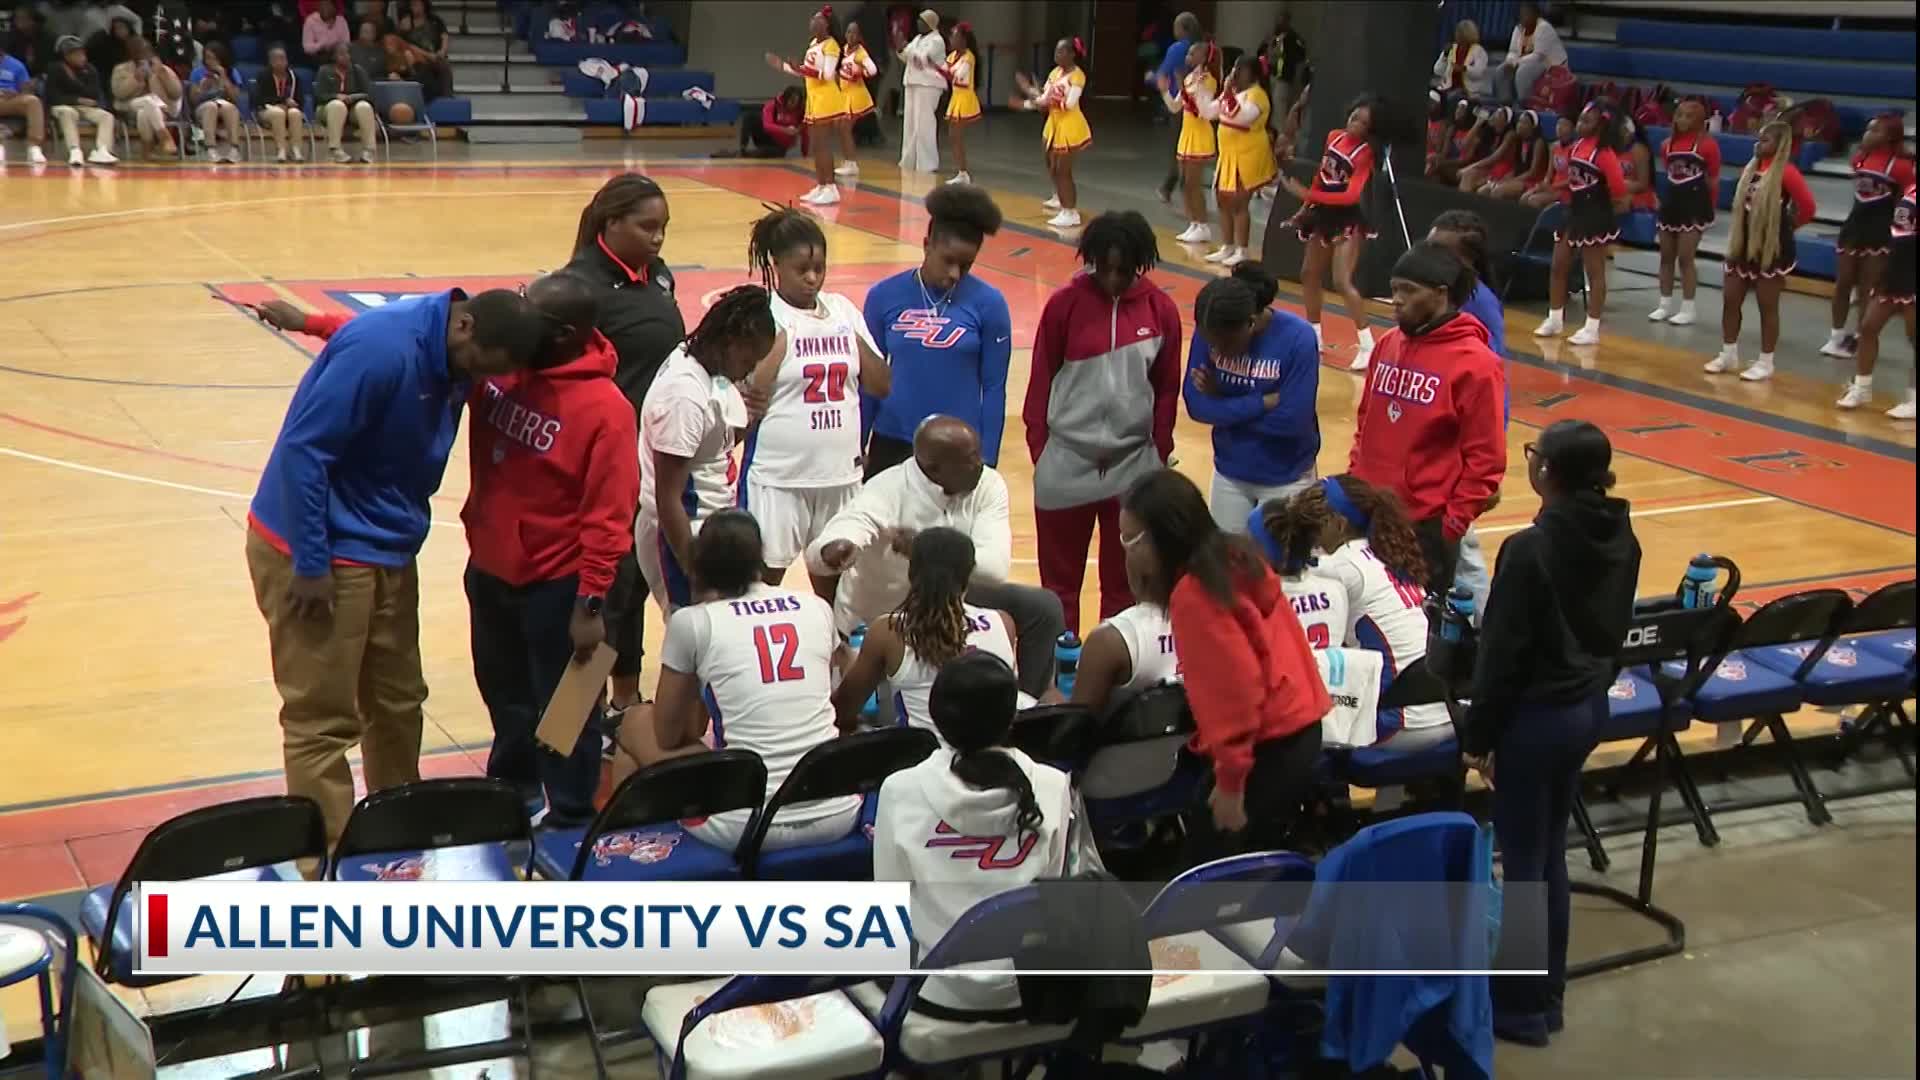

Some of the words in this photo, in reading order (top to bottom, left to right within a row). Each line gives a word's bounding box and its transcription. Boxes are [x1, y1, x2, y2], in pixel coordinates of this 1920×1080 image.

[795, 335, 850, 357] SAVANNAH
[802, 362, 848, 403] 20
[1371, 362, 1440, 404] TIGERS
[811, 409, 842, 430] STATE
[728, 595, 801, 616] TIGERS
[753, 623, 805, 684] 12
